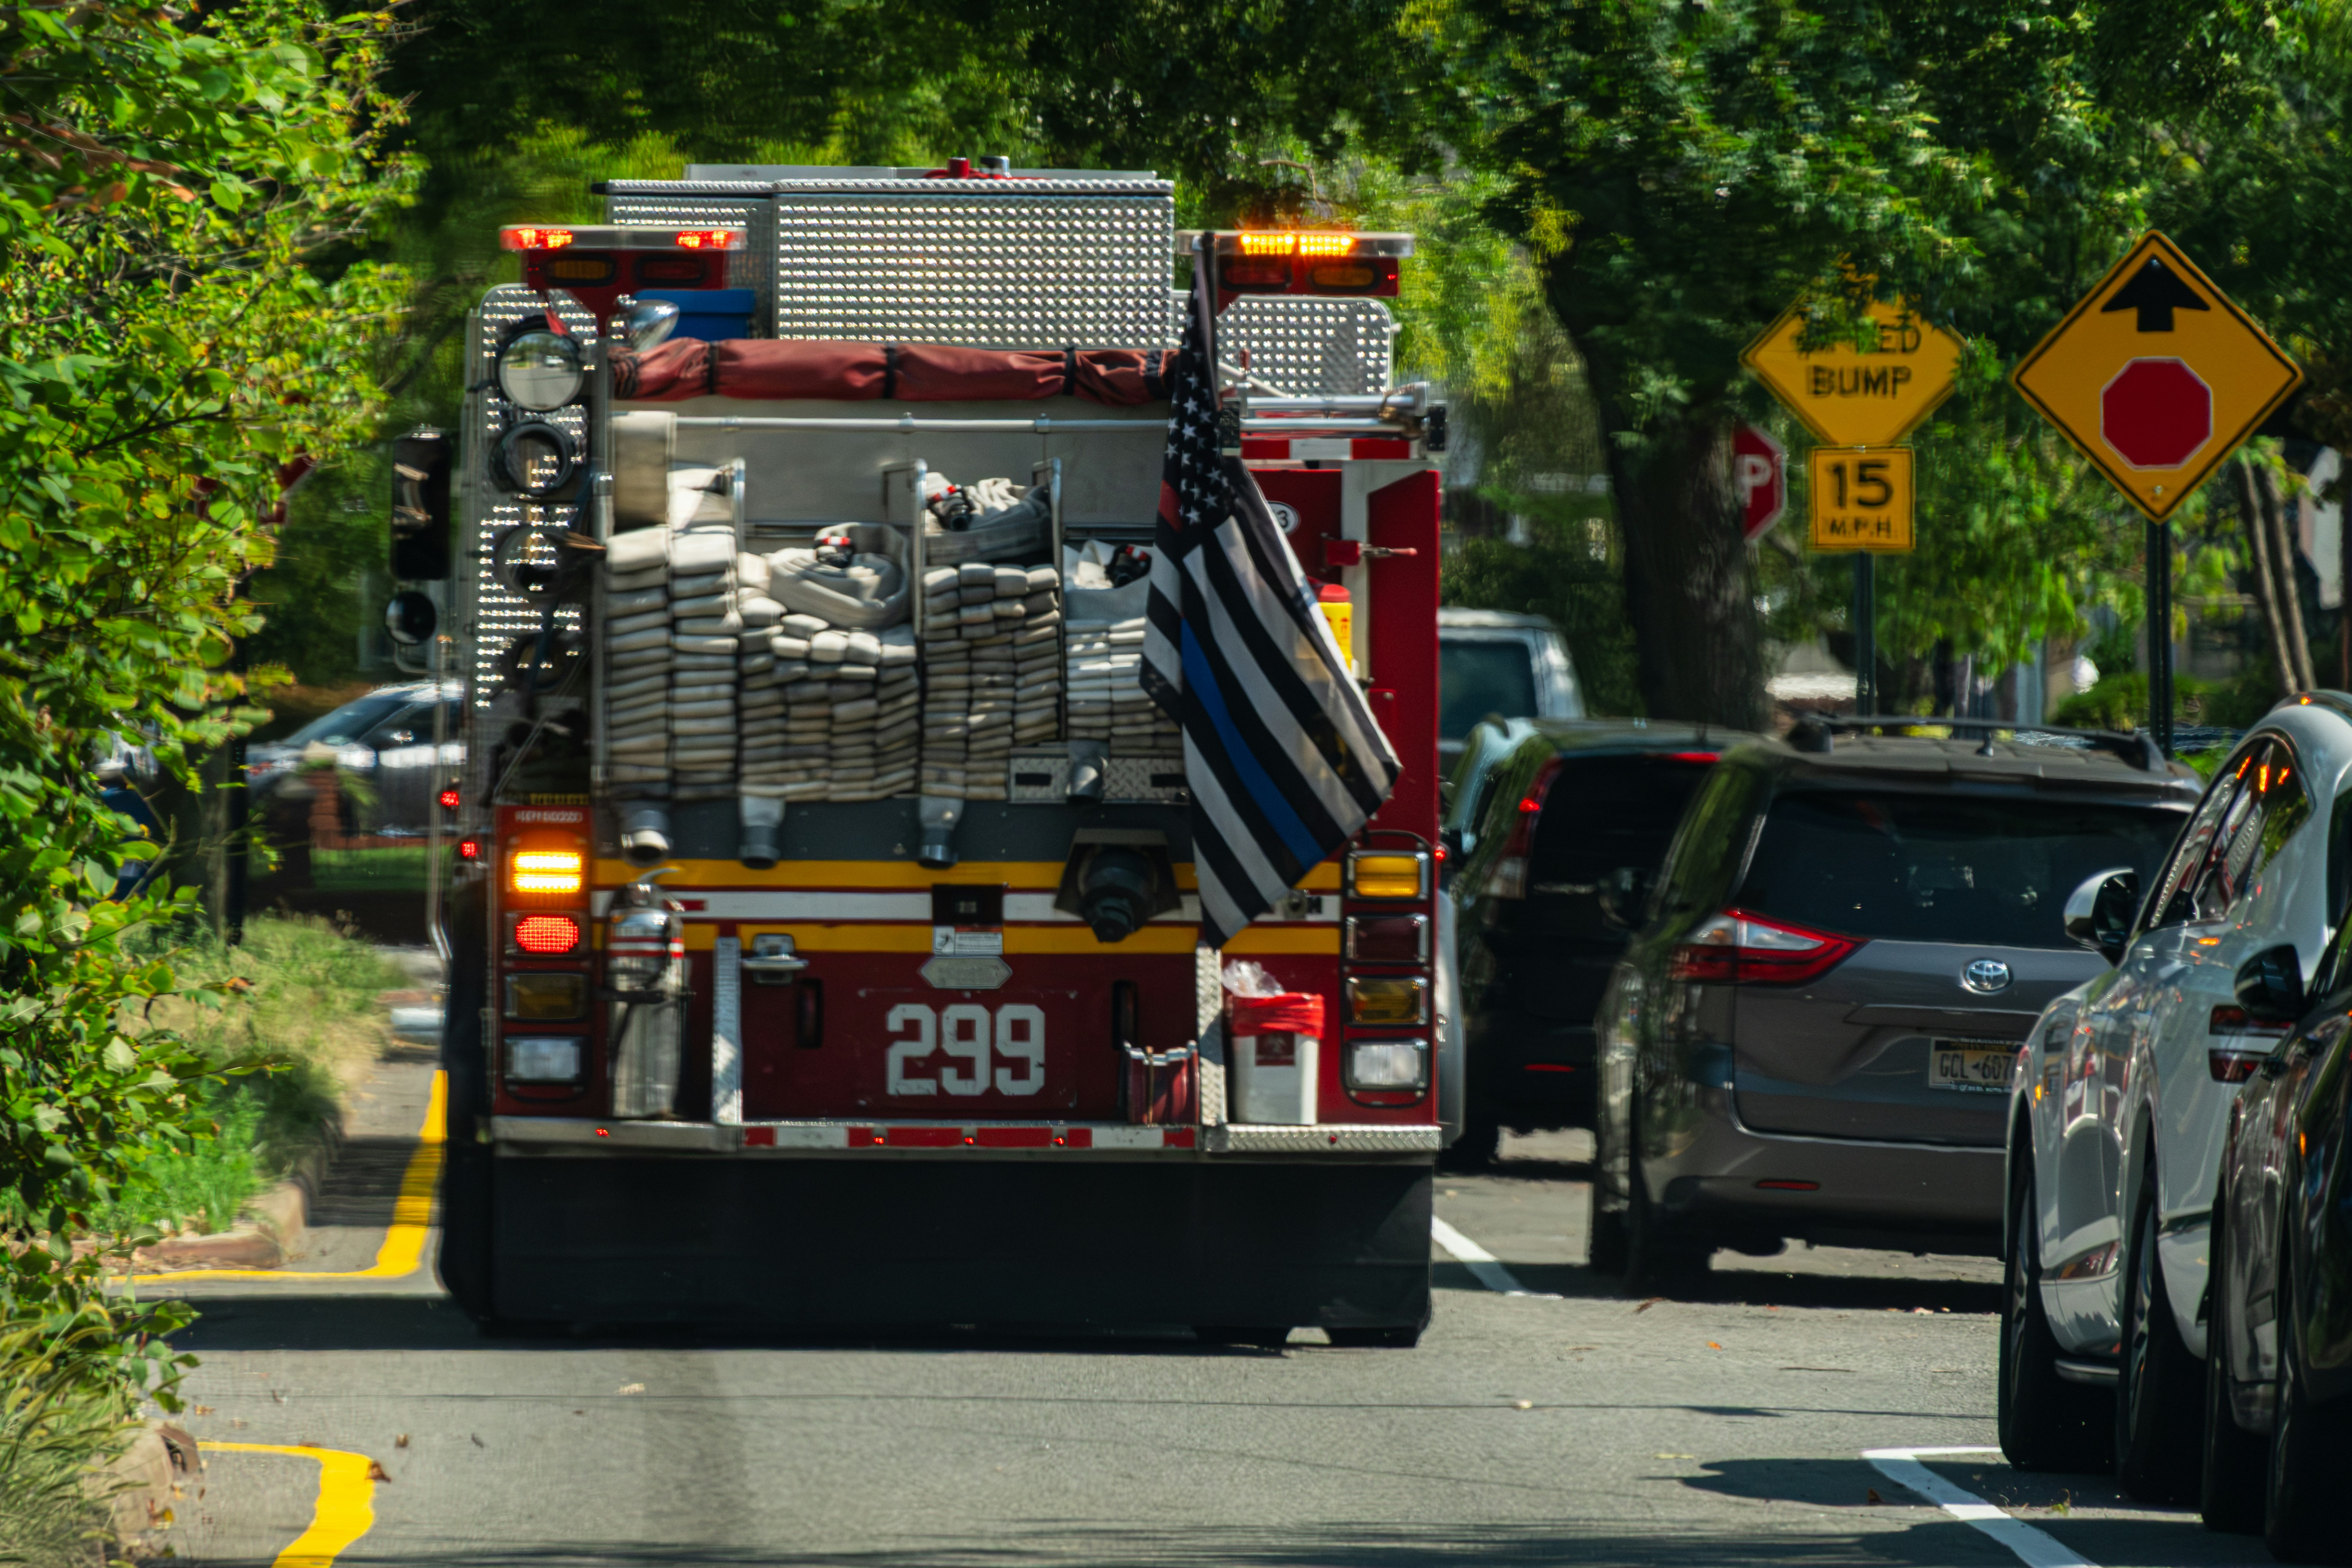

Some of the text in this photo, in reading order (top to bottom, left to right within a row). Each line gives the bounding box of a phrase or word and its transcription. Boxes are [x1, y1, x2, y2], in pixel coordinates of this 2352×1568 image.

[1811, 364, 1912, 399] BUMP
[1830, 459, 1894, 510] 15
[886, 1003, 1045, 1096] 299
[1941, 1054, 1969, 1079] GCL
